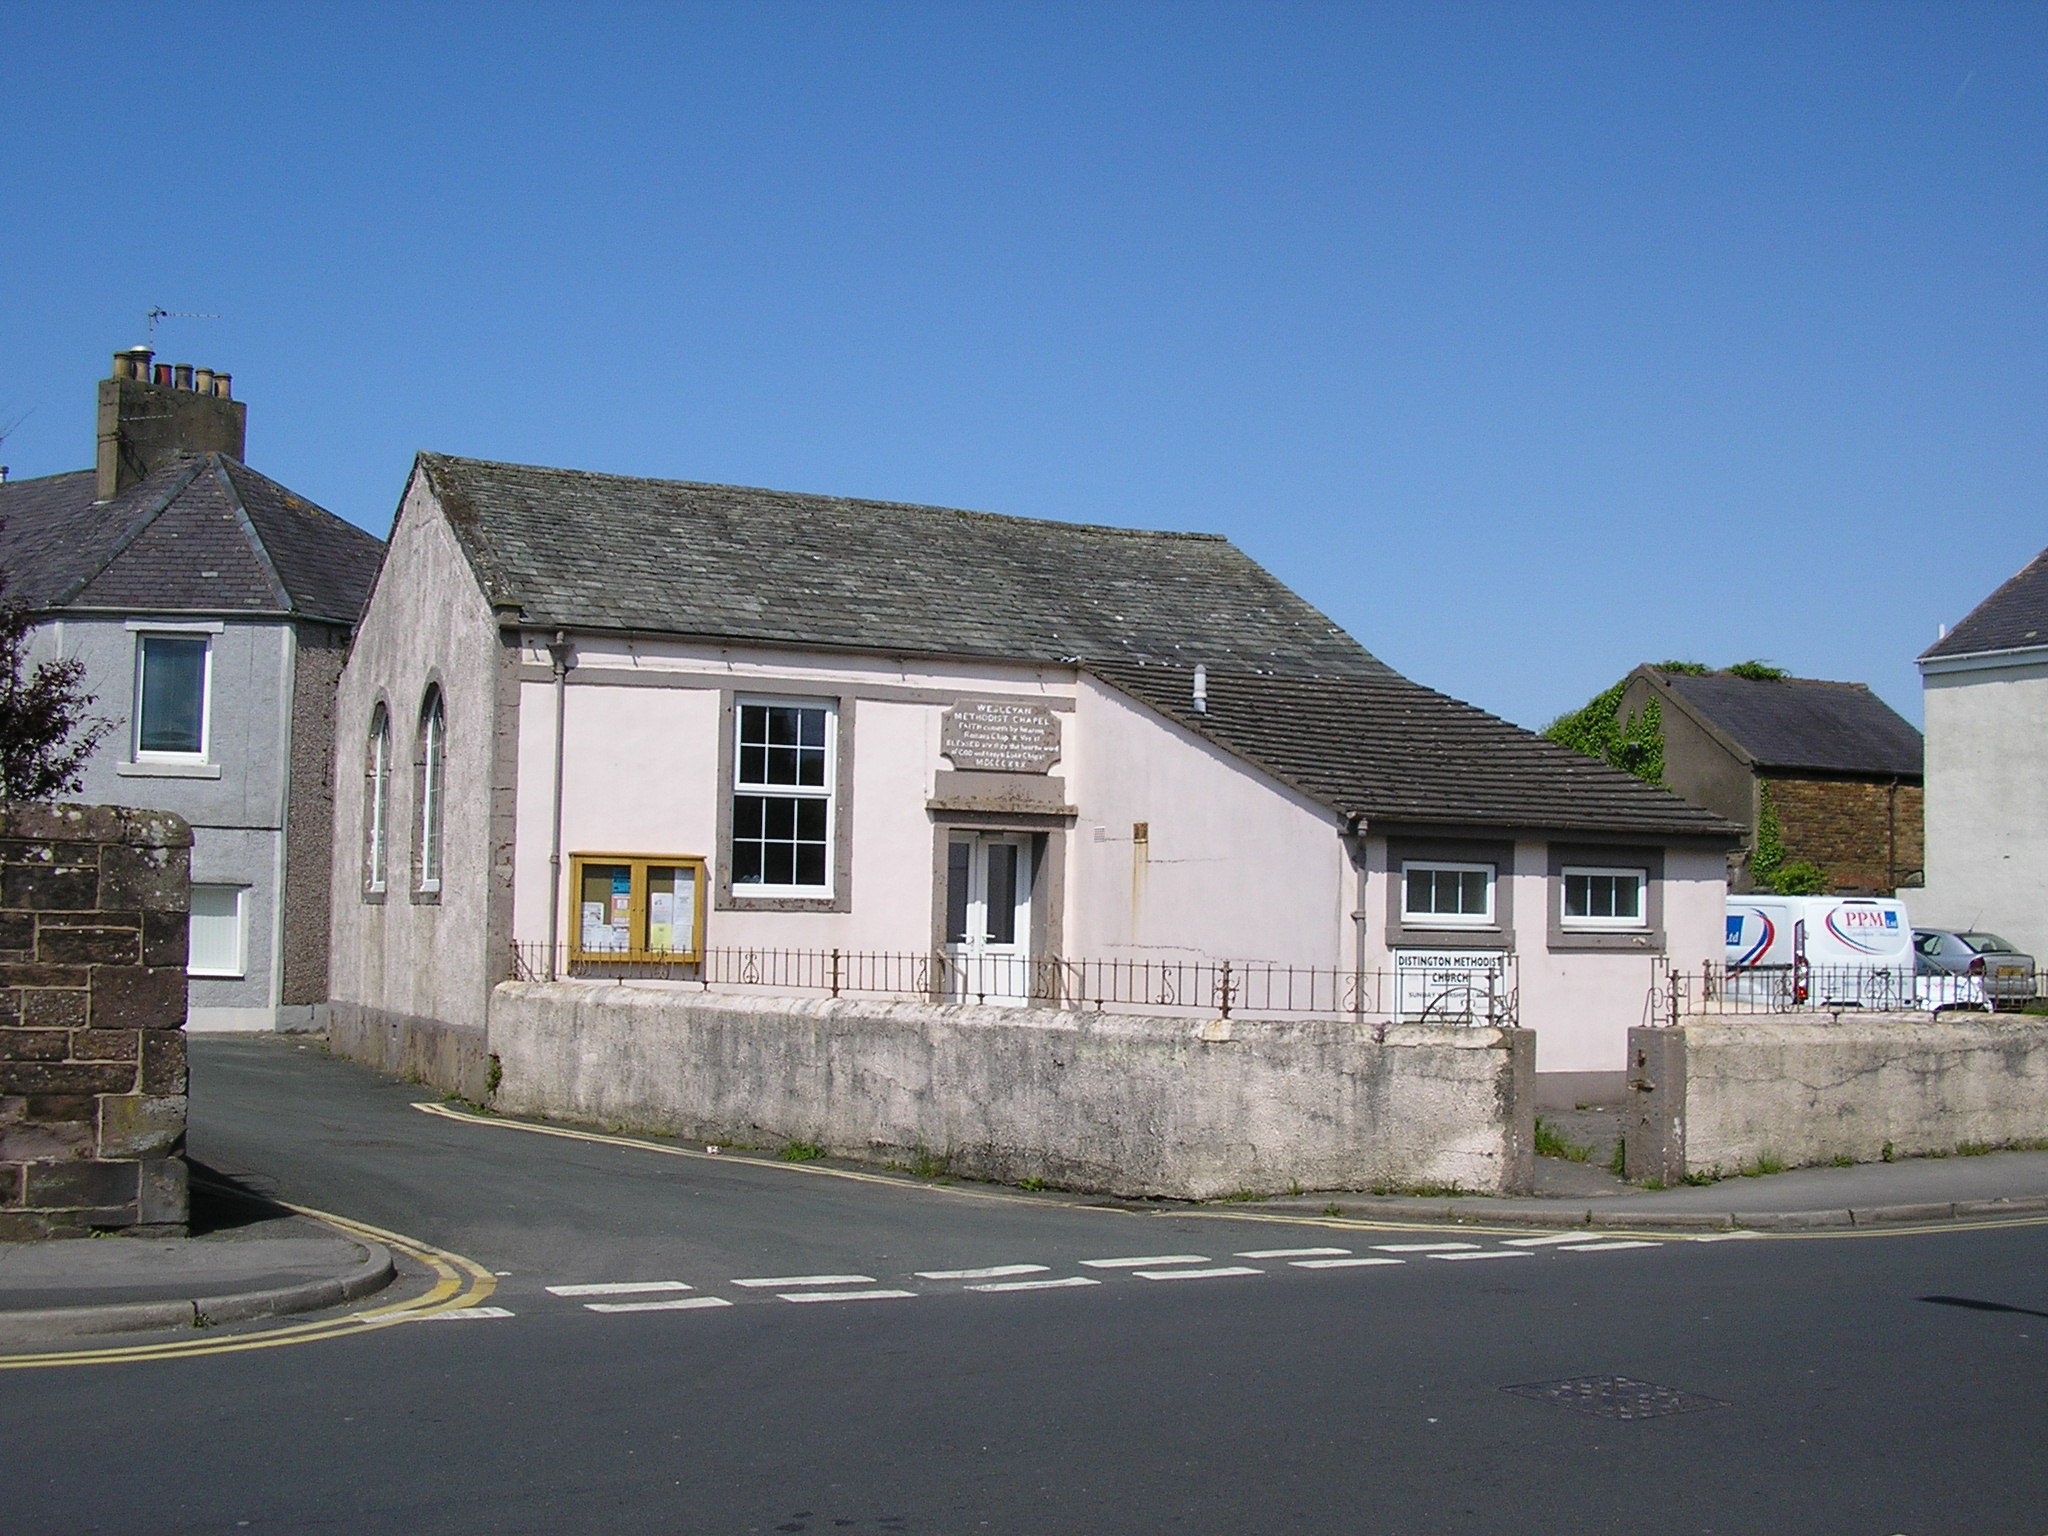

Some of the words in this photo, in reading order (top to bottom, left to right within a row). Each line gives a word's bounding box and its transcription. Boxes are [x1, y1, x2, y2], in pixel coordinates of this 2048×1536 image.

[977, 704, 1032, 715] WESLEYAN
[954, 712, 1009, 723] METHODIST
[1013, 716, 1050, 726] CHAPEL
[1845, 912, 1884, 927] PPM
[1398, 956, 1452, 967] DISTINGTON
[1453, 956, 1501, 967] METHODIST
[1432, 973, 1469, 983] CHURCH
